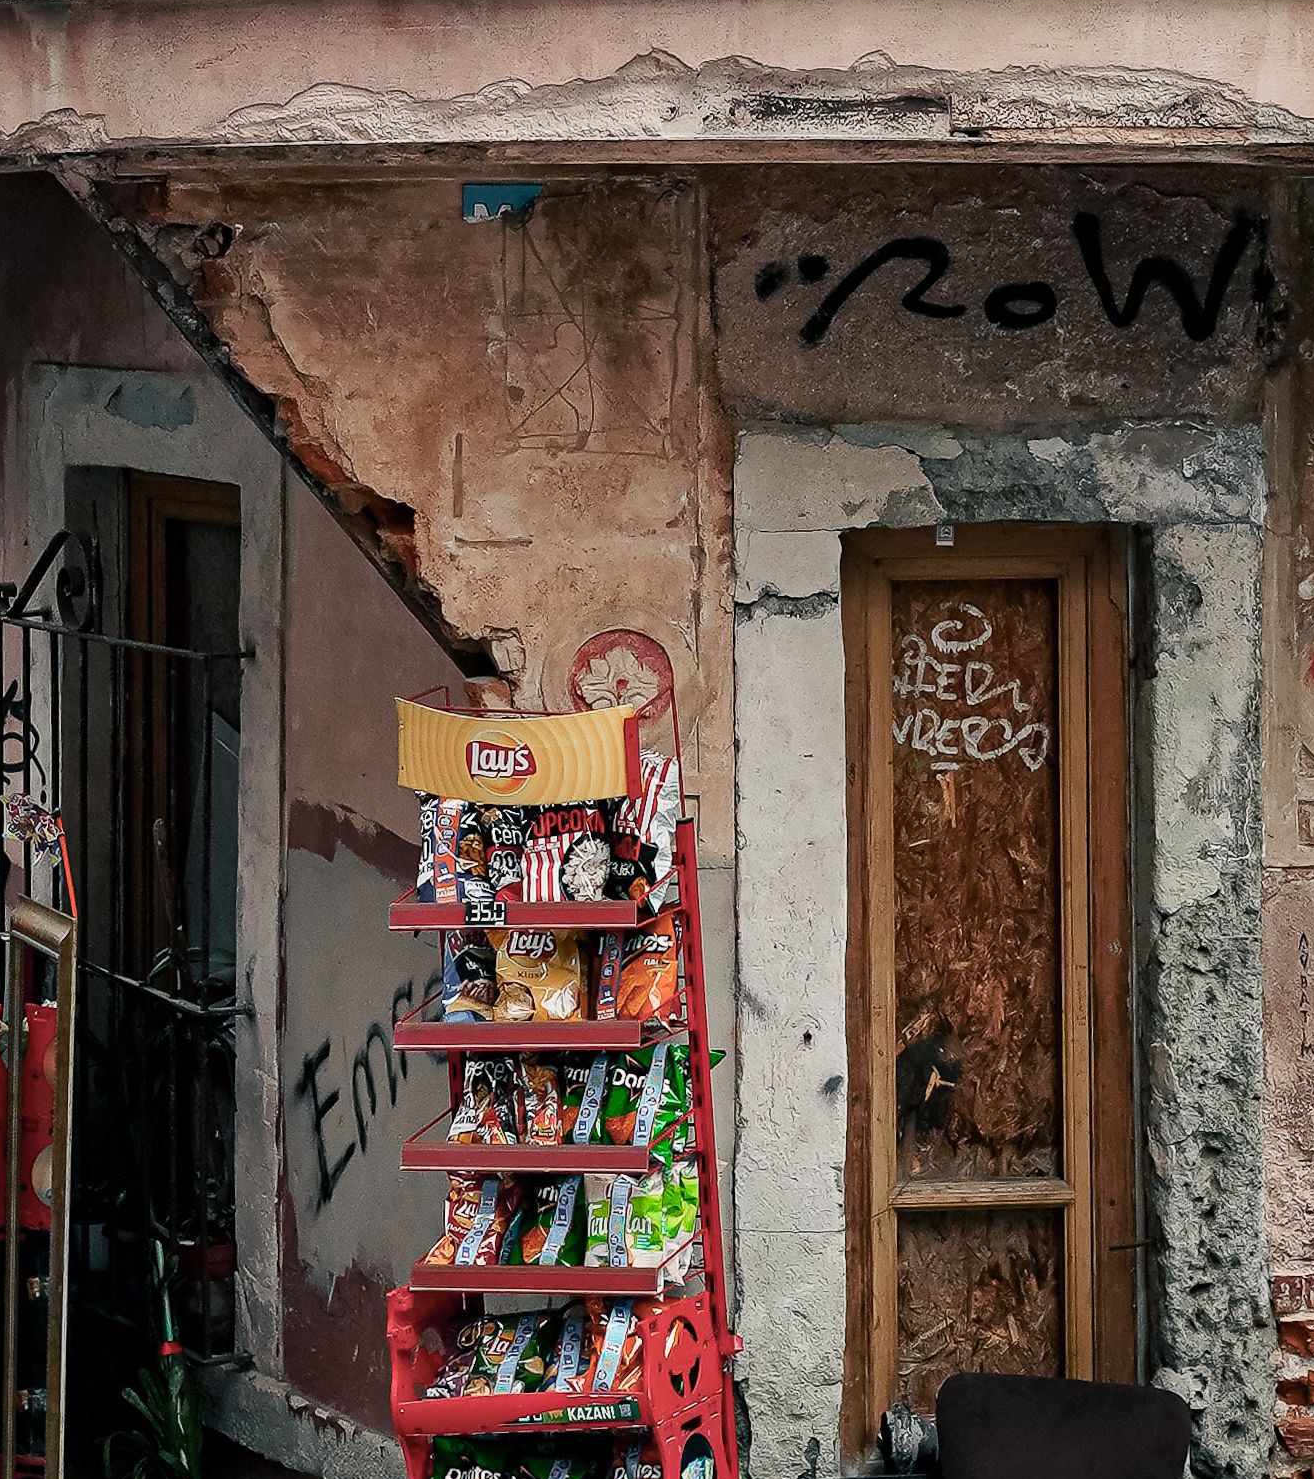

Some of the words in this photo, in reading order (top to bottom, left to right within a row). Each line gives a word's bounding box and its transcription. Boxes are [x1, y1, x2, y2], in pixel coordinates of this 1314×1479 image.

[471, 743, 529, 777] Lay's
[509, 931, 554, 959] Lay's
[567, 1405, 615, 1421] KAZAN!
